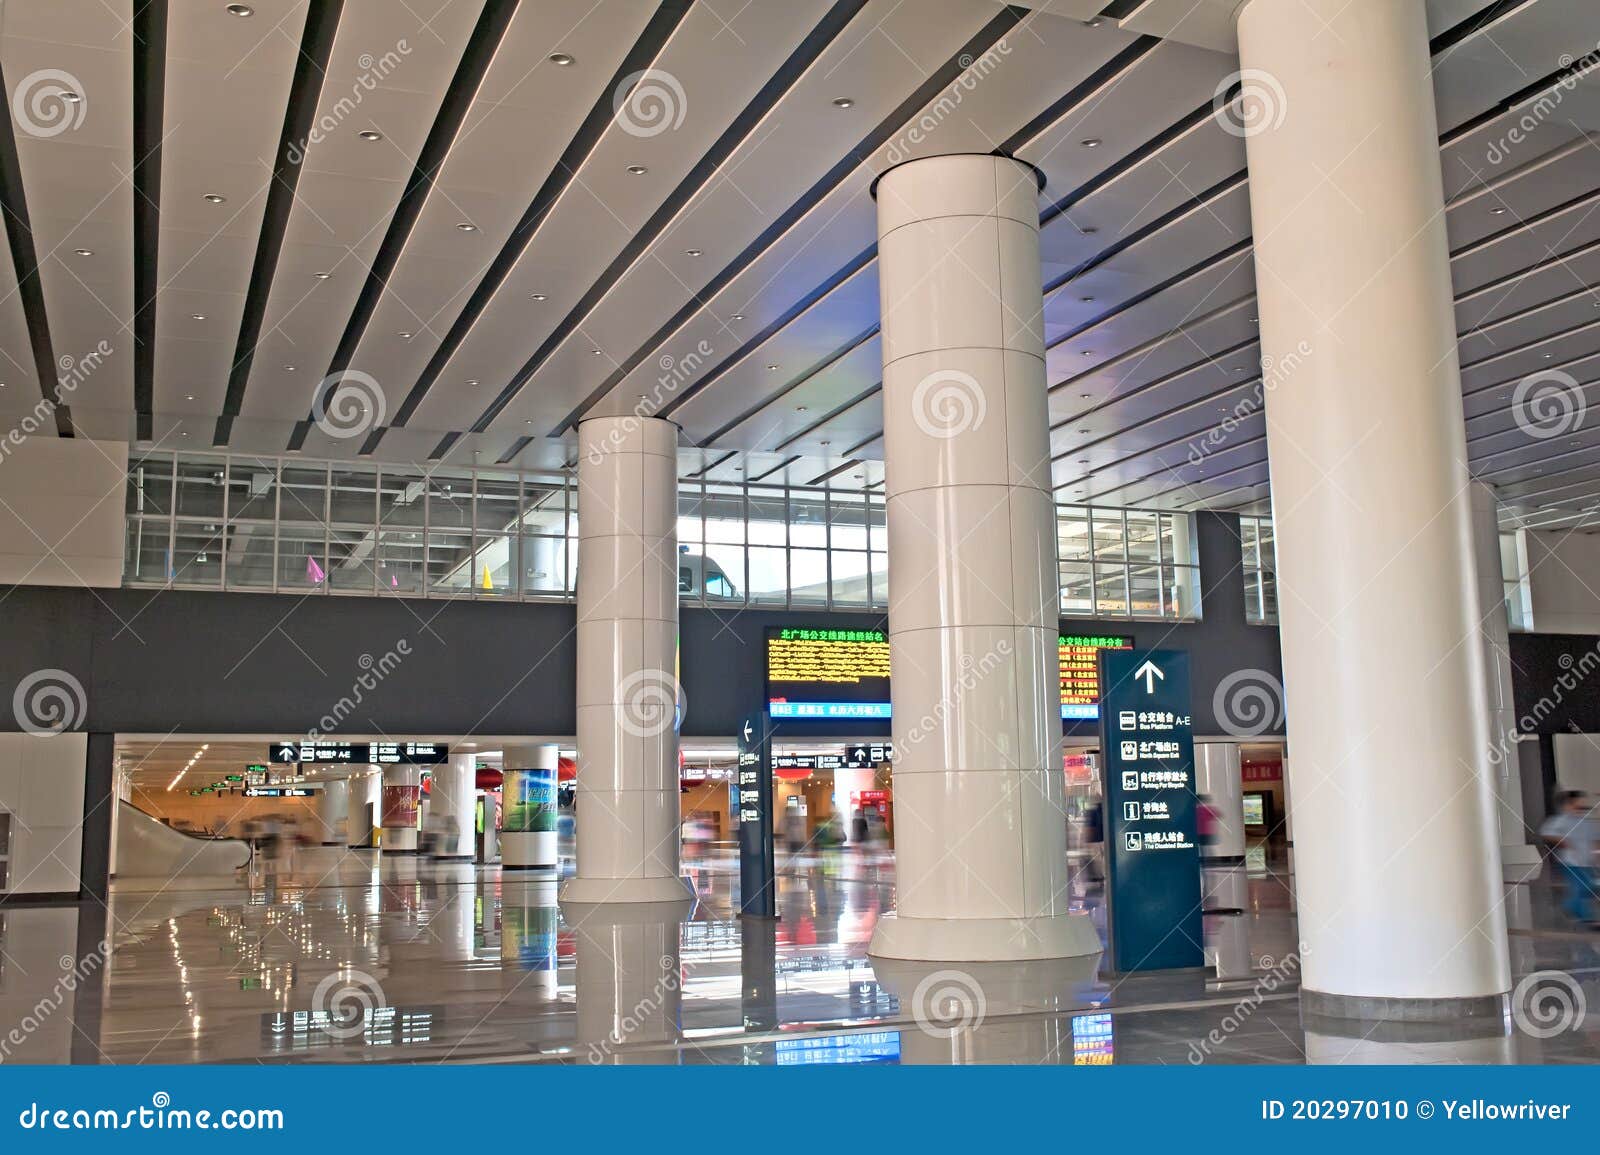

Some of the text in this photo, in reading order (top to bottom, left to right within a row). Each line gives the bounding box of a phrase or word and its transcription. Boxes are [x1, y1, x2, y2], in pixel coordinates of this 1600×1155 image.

[1138, 711, 1192, 726] 公交站台 A-E
[1139, 741, 1179, 752] 北广场出口
[1140, 771, 1188, 782] 自行车停放处
